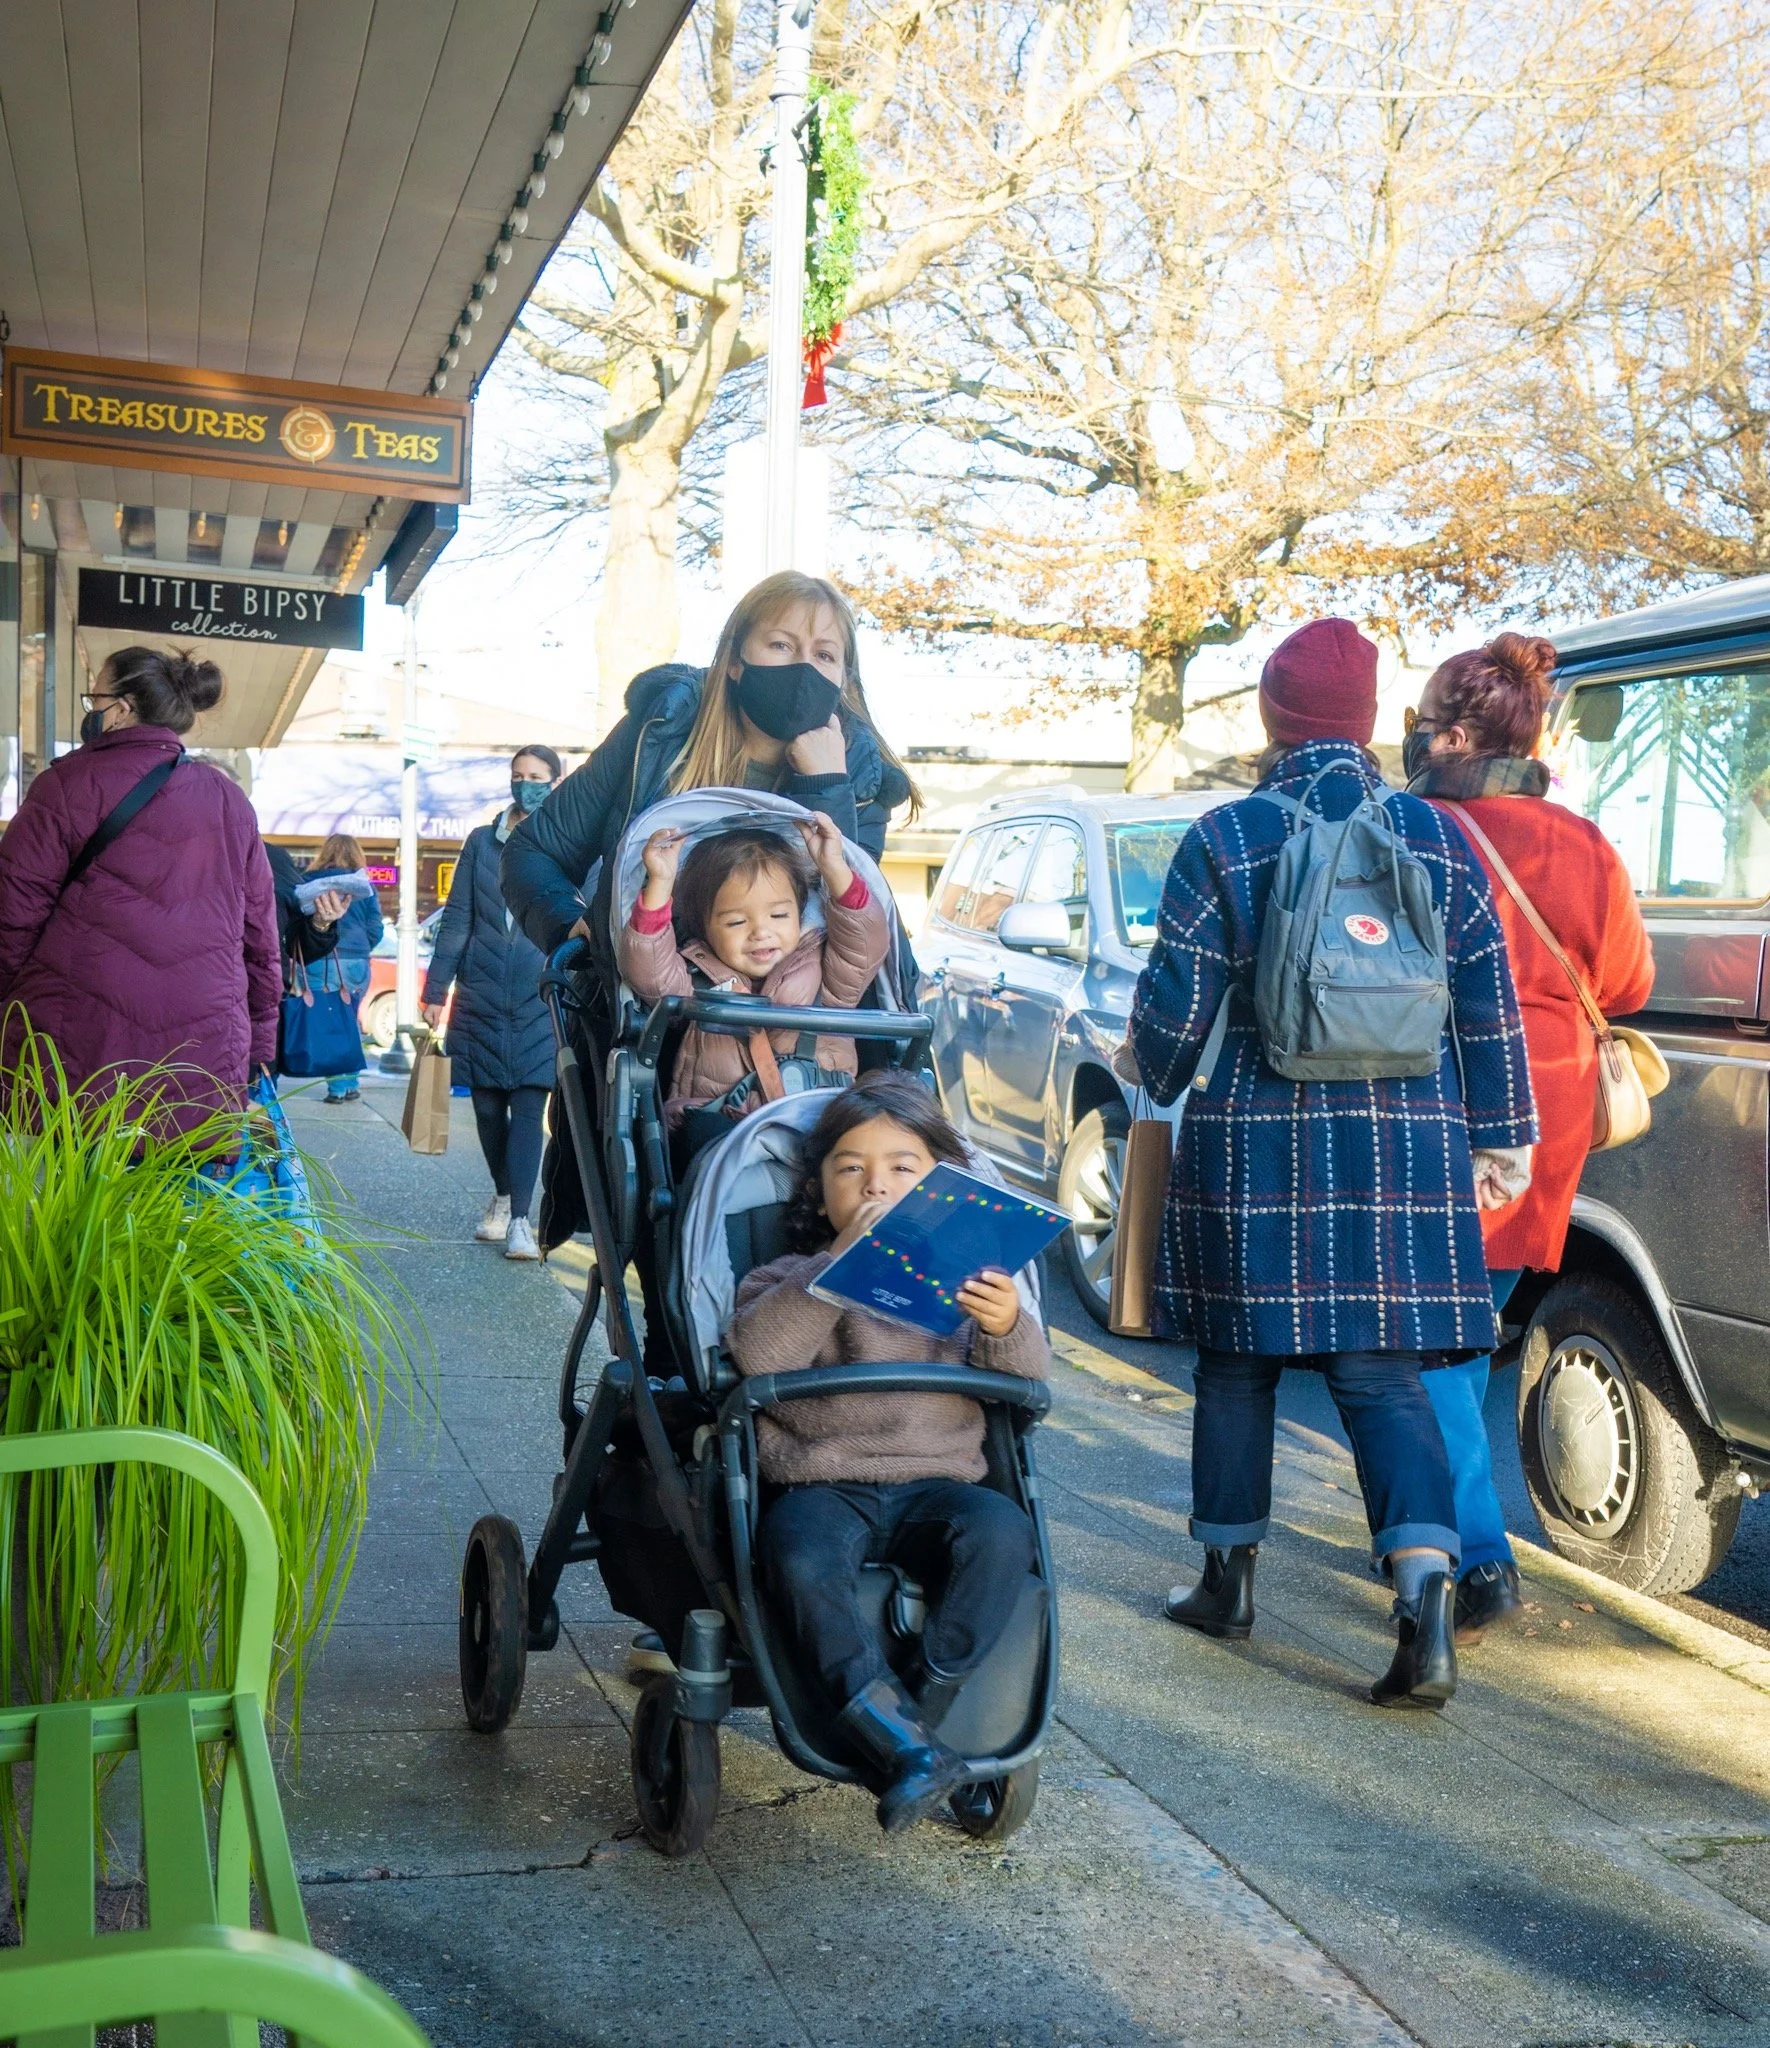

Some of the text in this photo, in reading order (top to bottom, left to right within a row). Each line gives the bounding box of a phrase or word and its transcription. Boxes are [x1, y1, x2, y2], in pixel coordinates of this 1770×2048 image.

[33, 383, 442, 464] TREASURES & TEAS
[119, 574, 326, 622] LITTLE BIPSY
[171, 612, 278, 641] collection
[430, 818, 465, 837] THAI
